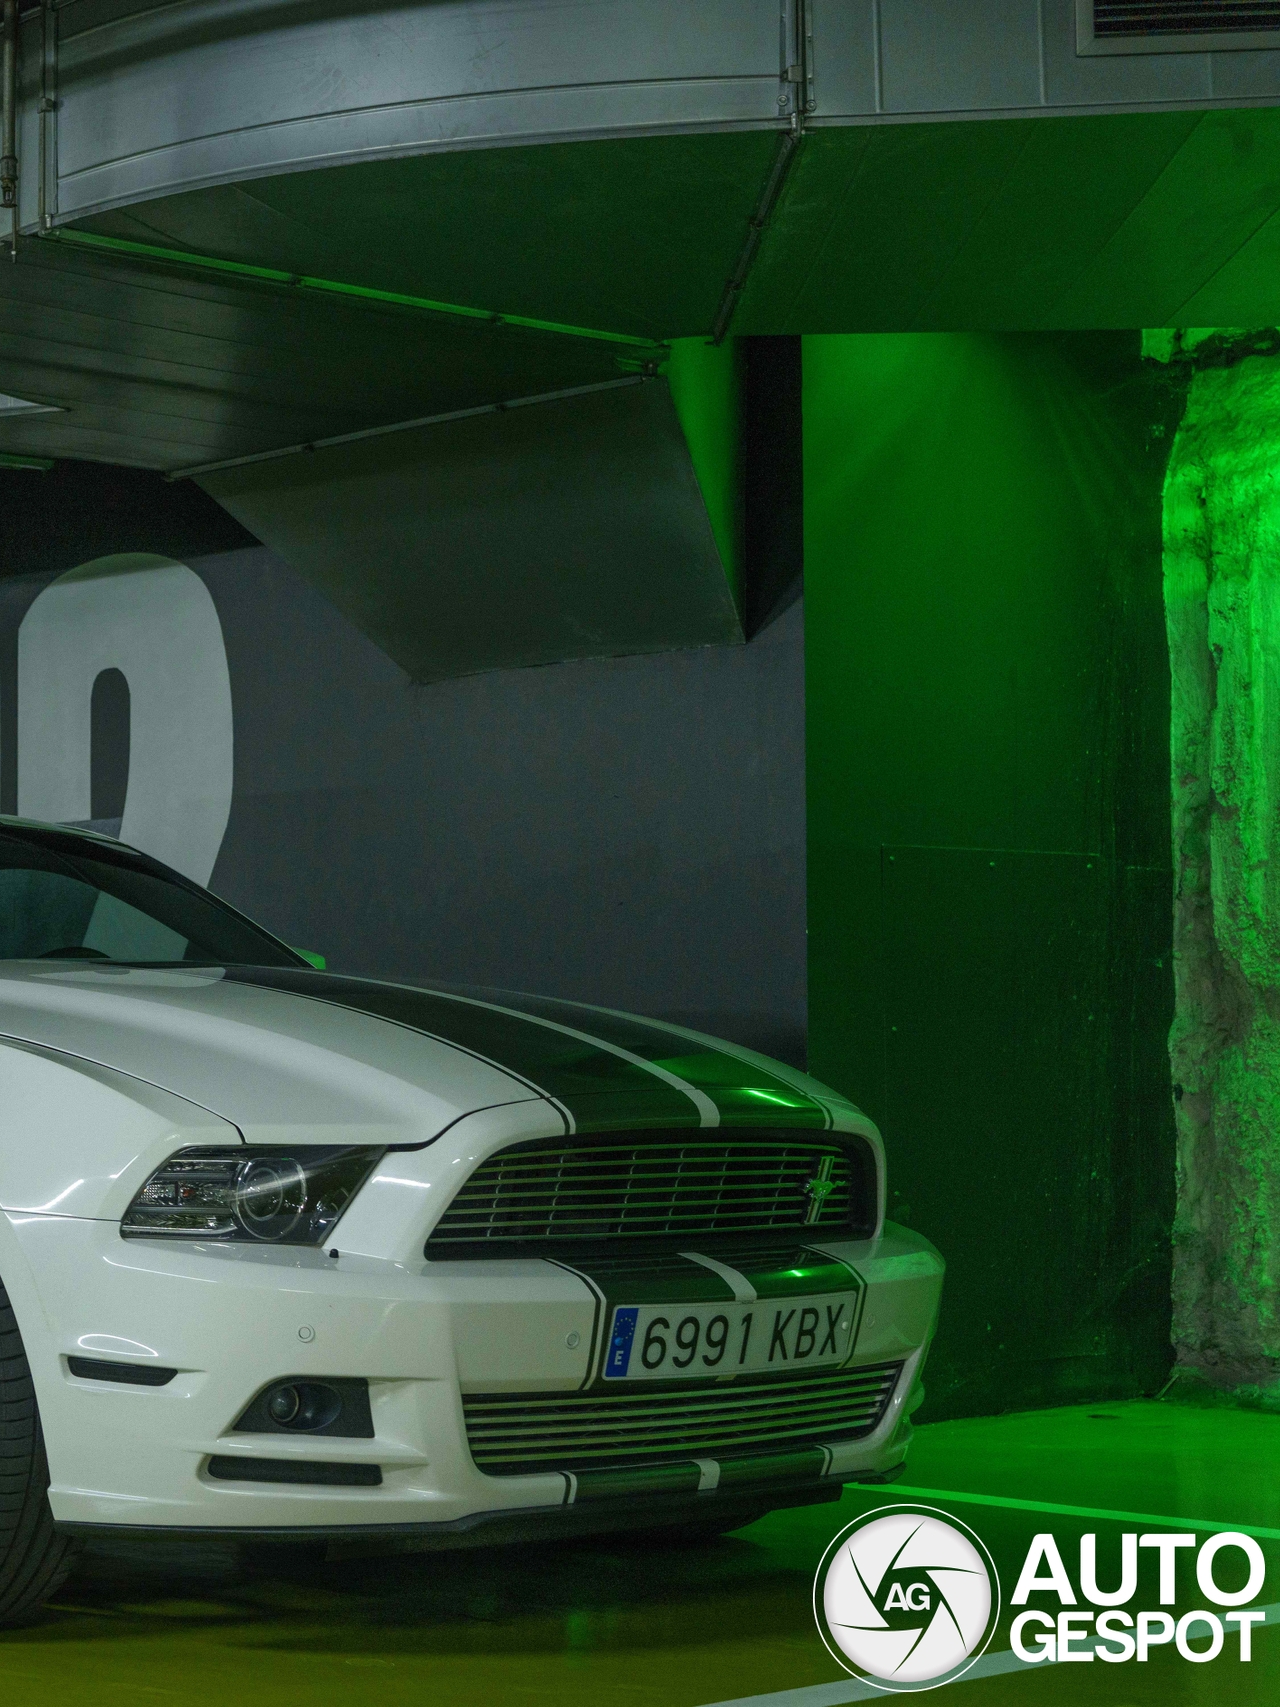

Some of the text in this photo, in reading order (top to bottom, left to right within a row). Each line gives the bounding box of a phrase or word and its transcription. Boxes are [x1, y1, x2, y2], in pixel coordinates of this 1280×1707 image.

[613, 1303, 845, 1370] E 6991 KBX
